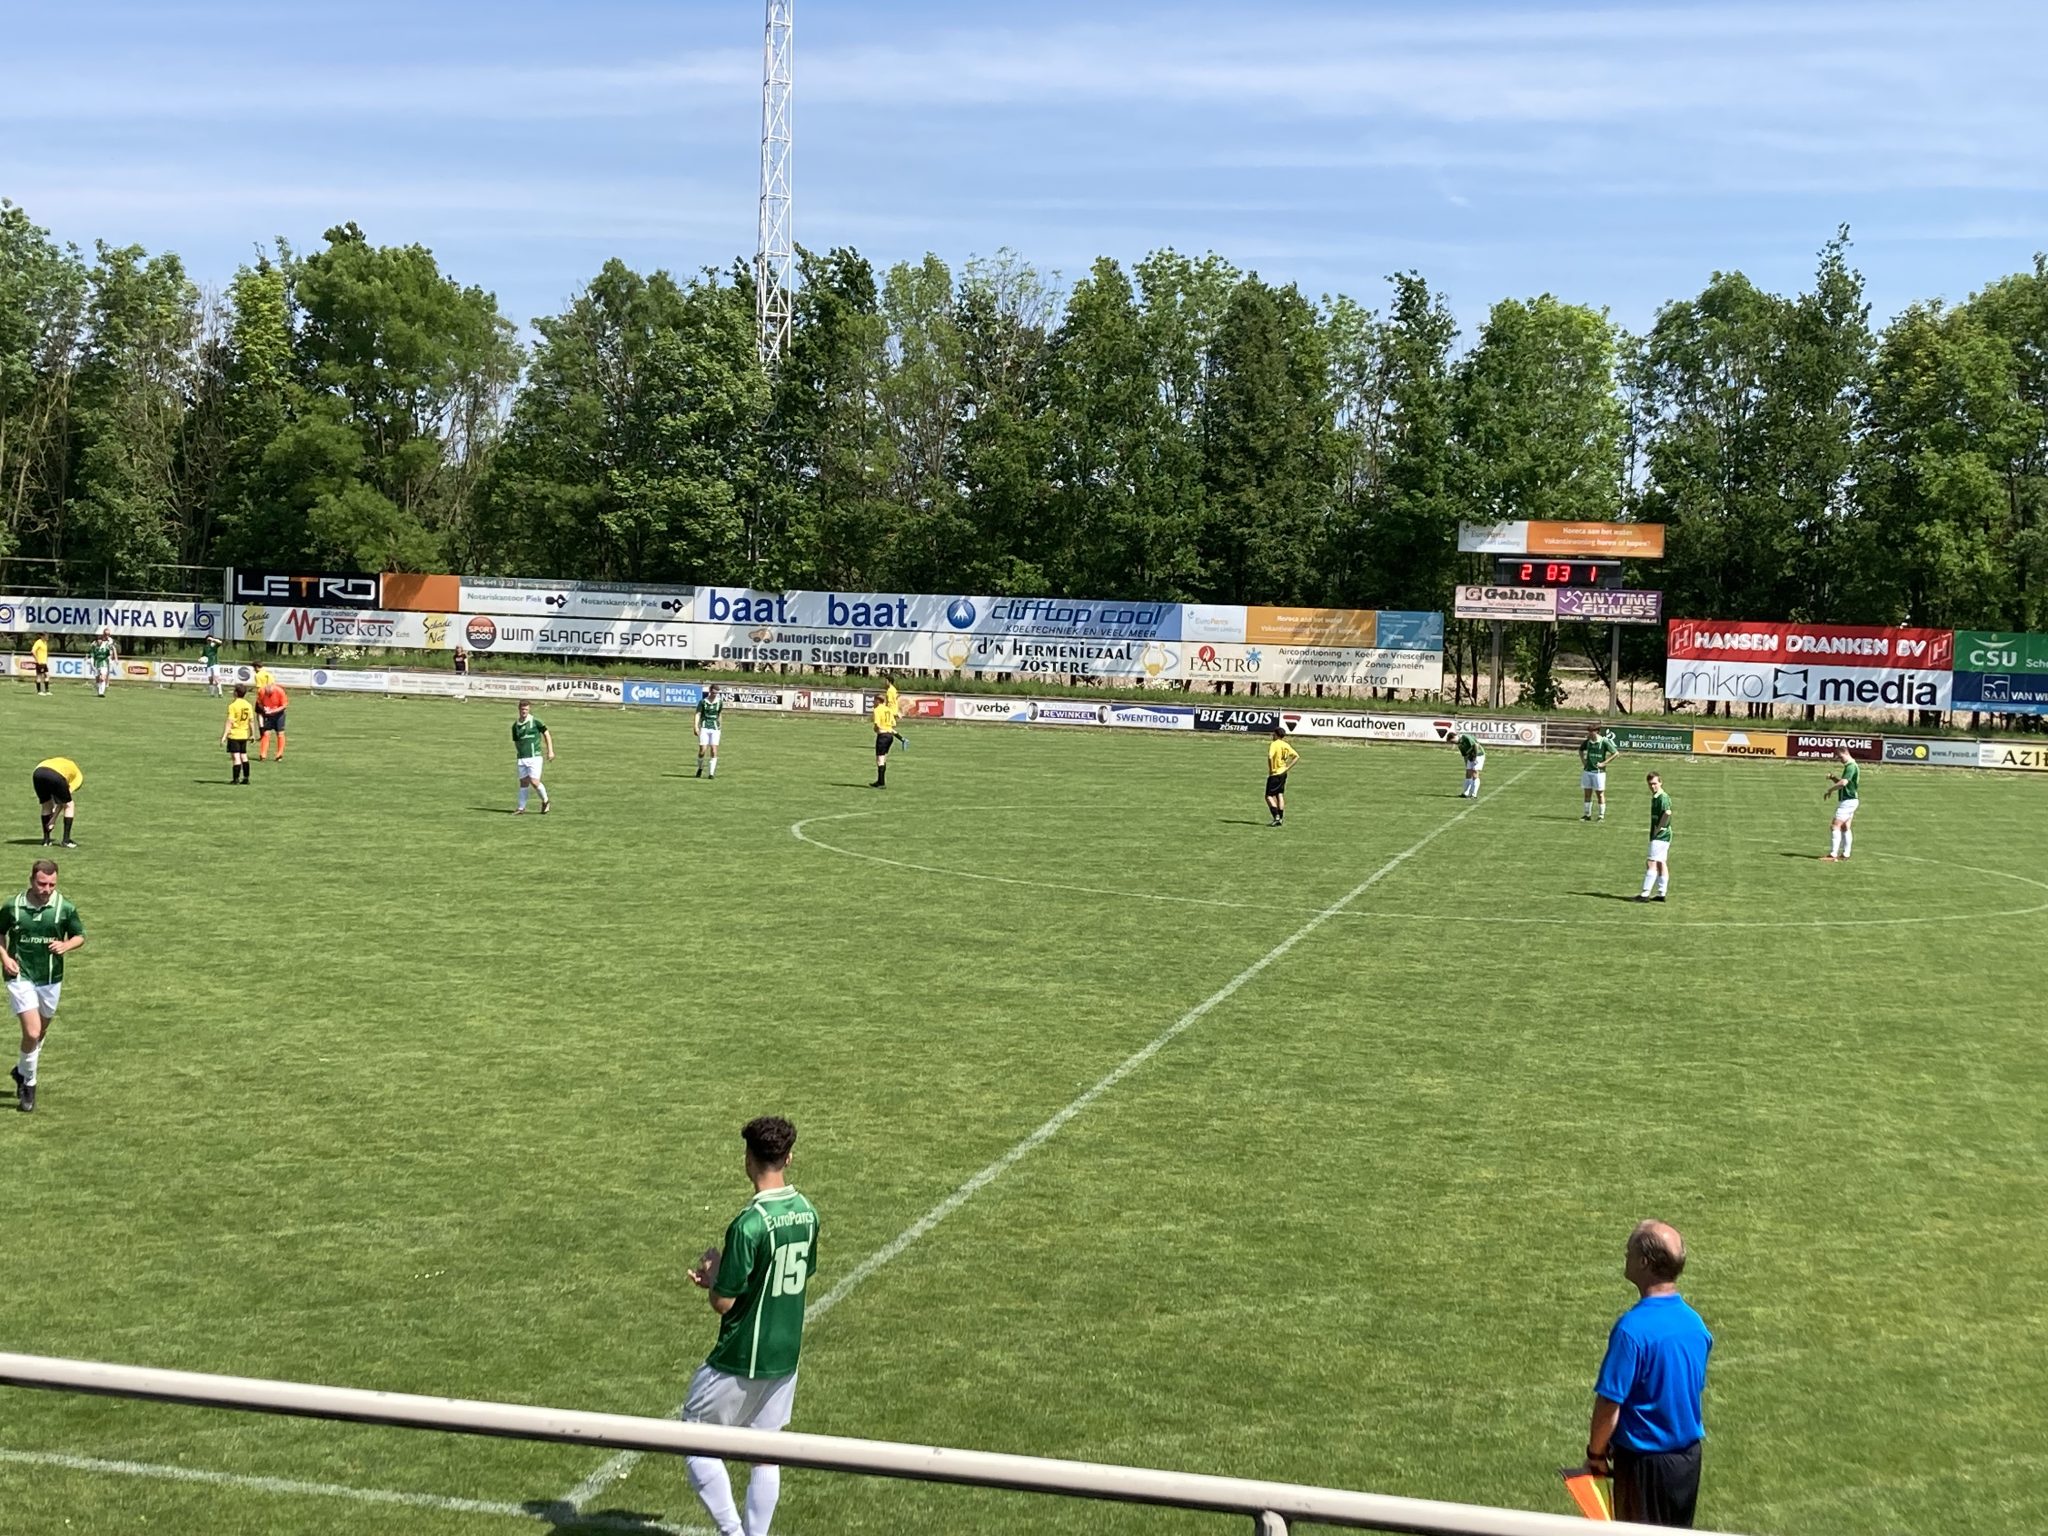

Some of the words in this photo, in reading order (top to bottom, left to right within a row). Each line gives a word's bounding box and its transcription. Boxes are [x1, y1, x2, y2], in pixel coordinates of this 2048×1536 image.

[1521, 564, 1532, 580] 2
[1590, 566, 1597, 582] 1
[238, 574, 376, 600] LETRO
[467, 593, 524, 602] Notariskantoor
[1484, 588, 1546, 601] Gehlen
[1581, 592, 1657, 606] ANYTIME
[581, 598, 639, 607] Notariskantoor
[709, 589, 797, 624] baat.
[828, 594, 917, 628] baat.
[991, 600, 1091, 626] clifftop
[1100, 605, 1163, 625] cool
[1582, 604, 1657, 616] FITNESS
[26, 606, 91, 625] BLOEM
[98, 608, 157, 627] INFRA
[163, 611, 188, 629] BV
[321, 617, 394, 637] Beckers
[1005, 624, 1079, 636] KOELTECHNIEK
[1084, 628, 1097, 636] EN
[1101, 628, 1124, 637] VEEL
[502, 627, 534, 641] WIM
[539, 629, 614, 645] SLANGEN
[620, 632, 688, 648] SPORTS
[1694, 632, 1779, 651] HANSEN
[1786, 635, 1889, 656] DRANKEN
[1896, 639, 1926, 657] BV
[712, 644, 802, 661] Jeurissen
[811, 648, 910, 666] Susteren.nl
[1279, 648, 1342, 658] Airconditioning
[1969, 650, 2017, 667] CSU
[56, 660, 82, 674] ICE
[1020, 656, 1090, 674] ZÖSTERE
[1189, 657, 1260, 673] FASTRO
[1286, 658, 1352, 668] Warmtepompen
[1365, 661, 1424, 670] Zonnepanelen
[2026, 659, 2048, 668] Sch
[666, 688, 696, 696] RENTAL
[1680, 665, 1763, 698] mikro
[1819, 673, 1937, 706] media
[739, 694, 778, 704] WAGTER
[1984, 690, 2006, 700] SAA
[2011, 691, 2033, 701] VAN
[812, 698, 854, 708] MEUFFELS
[1043, 710, 1093, 719] REWINKEL
[1116, 713, 1179, 724] SWENTIBOLD
[1311, 718, 1333, 727] van
[1337, 717, 1405, 730] Kaathoven
[1456, 721, 1516, 733] SCHOLTES
[1619, 740, 1629, 748] DE
[1798, 737, 1872, 749] MOUSTACHE
[1727, 746, 1776, 755] MOURIK
[1885, 743, 1913, 757] Fysio
[771, 1242, 809, 1297] 15
